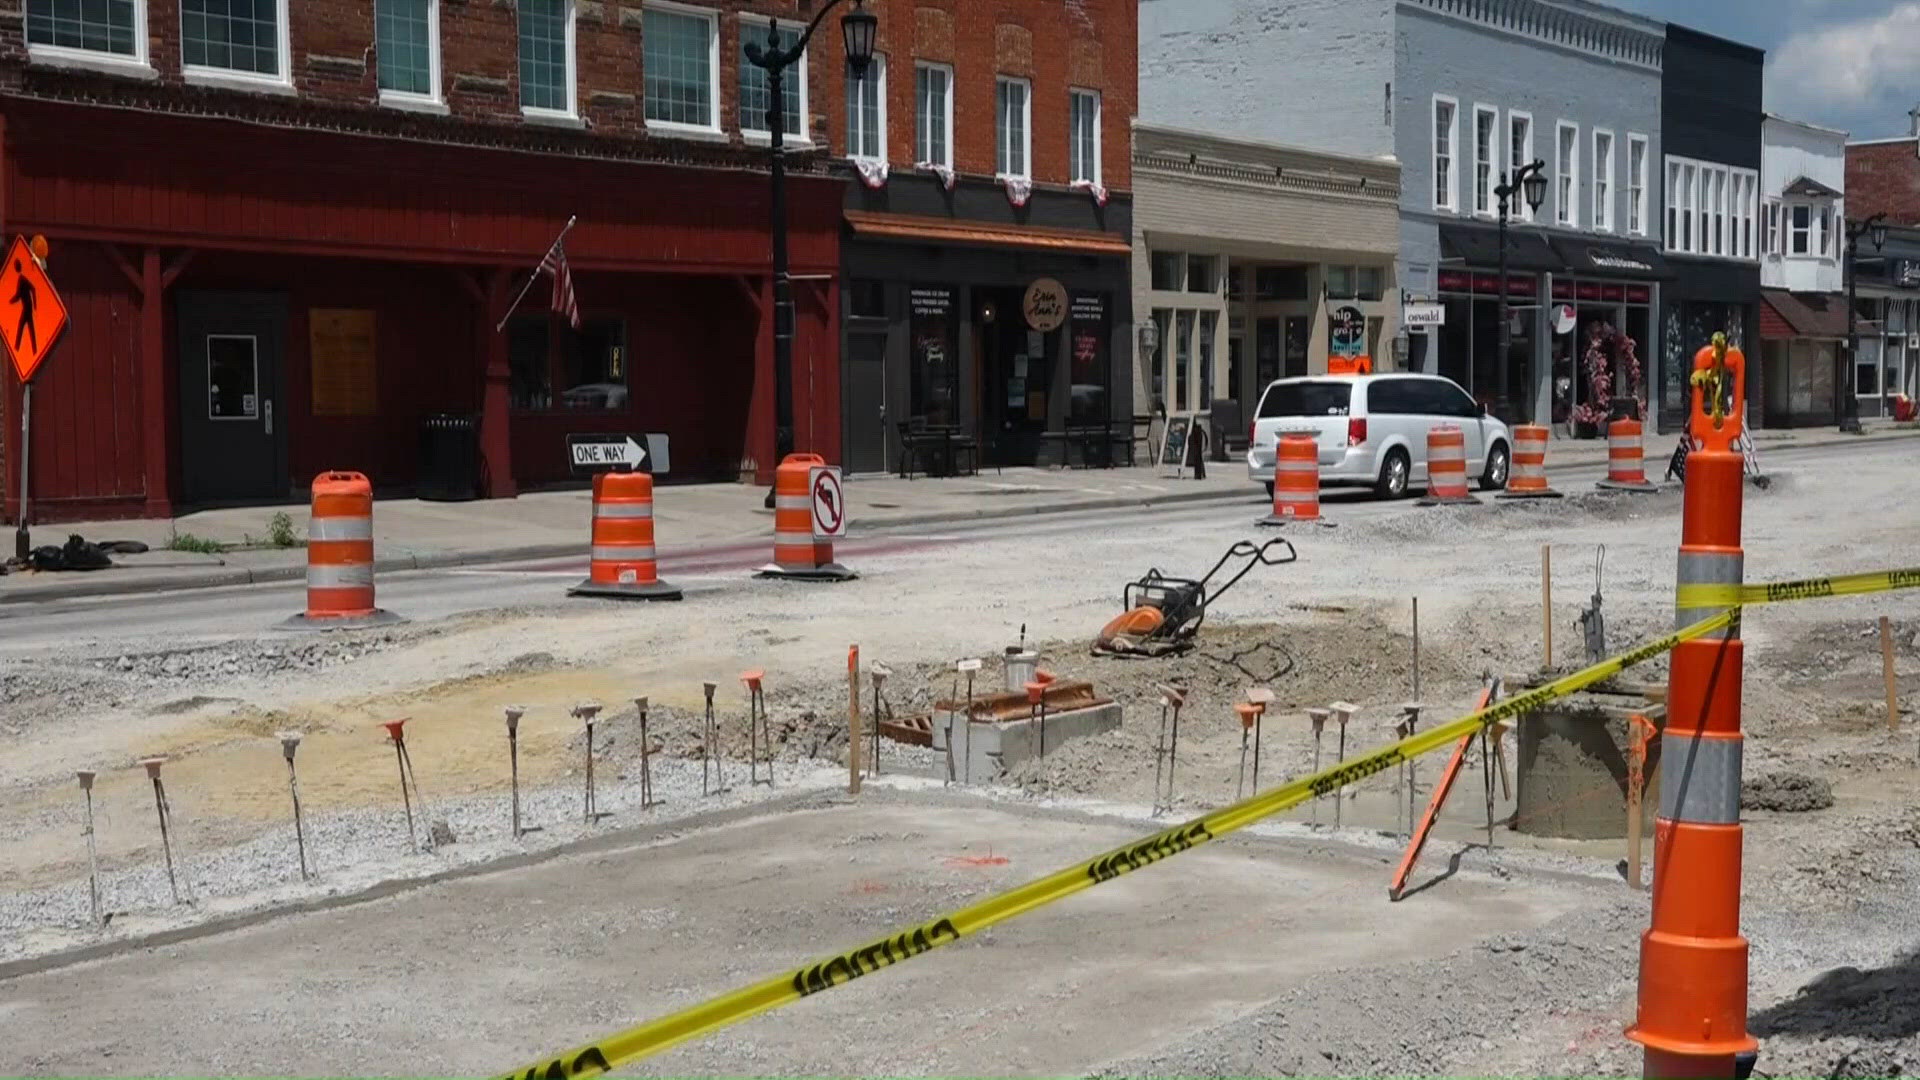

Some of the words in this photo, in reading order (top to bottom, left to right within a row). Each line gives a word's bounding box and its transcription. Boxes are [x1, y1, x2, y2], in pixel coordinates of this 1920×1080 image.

[1408, 309, 1439, 322] oswald
[576, 446, 600, 462] ONE
[602, 446, 625, 461] WAY
